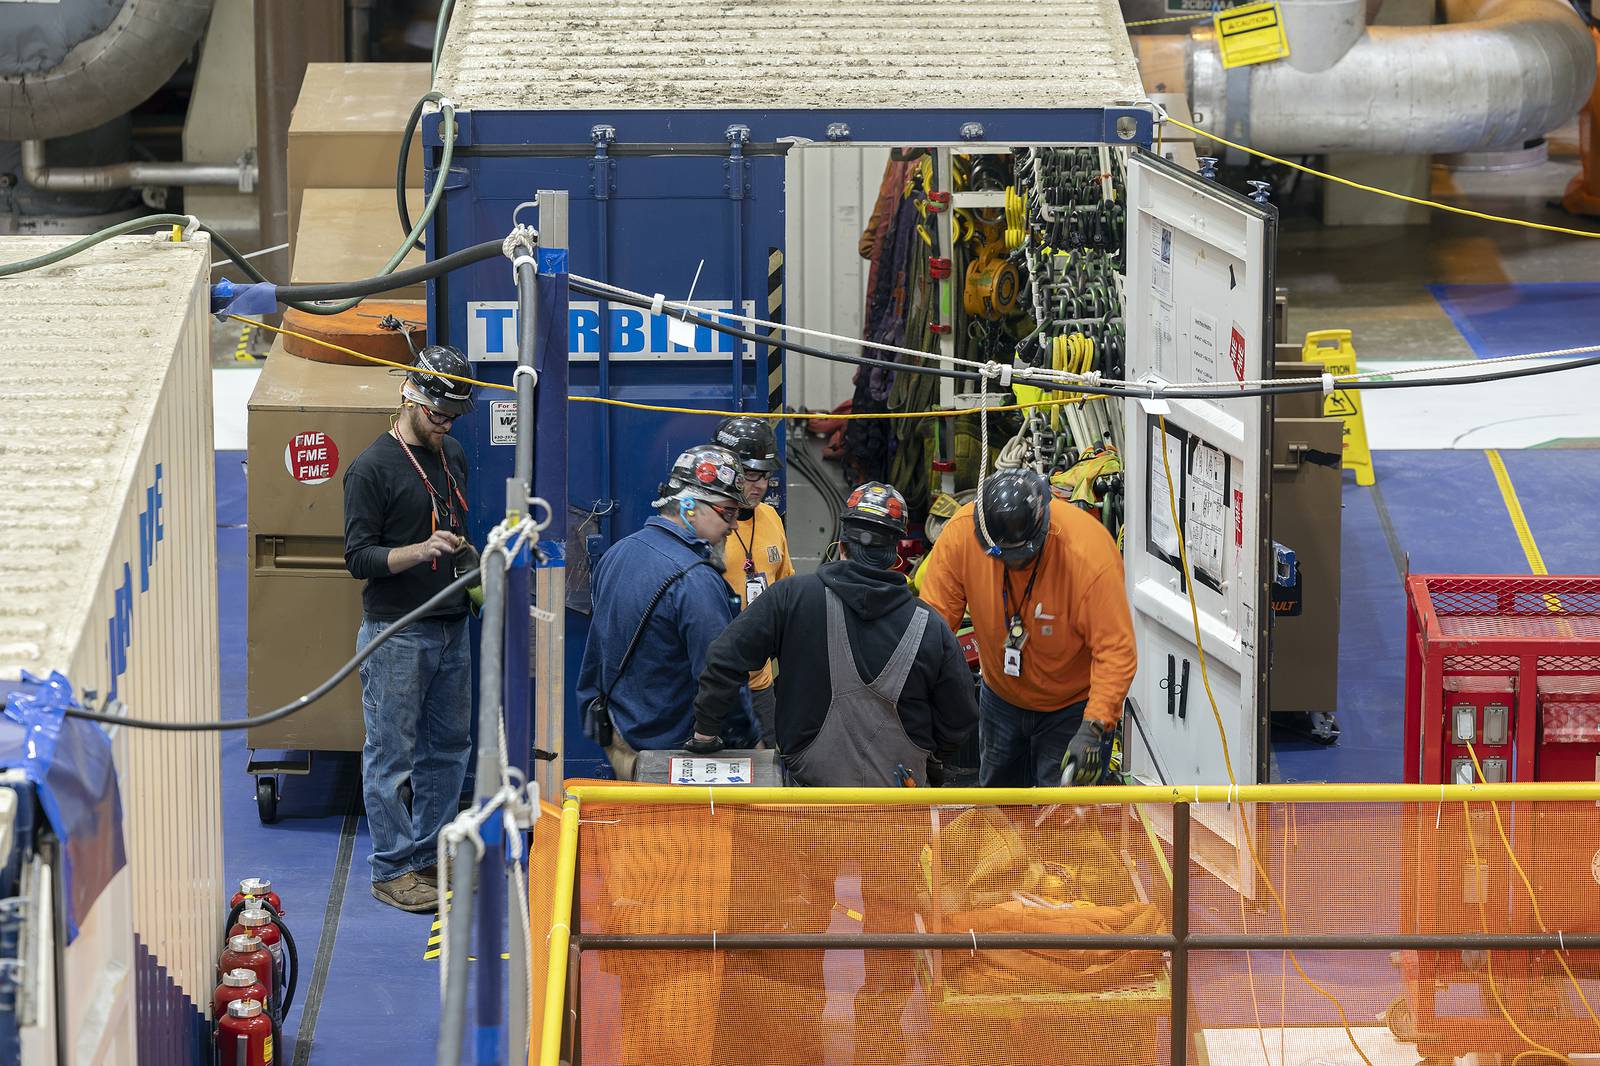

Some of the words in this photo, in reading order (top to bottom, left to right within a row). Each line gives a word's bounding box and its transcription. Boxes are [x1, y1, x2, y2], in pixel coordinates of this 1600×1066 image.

[1233, 16, 1269, 28] CAUTION
[476, 308, 749, 353] TRBINE
[295, 432, 325, 447] FME
[297, 448, 327, 462] FME
[299, 463, 330, 478] FME
